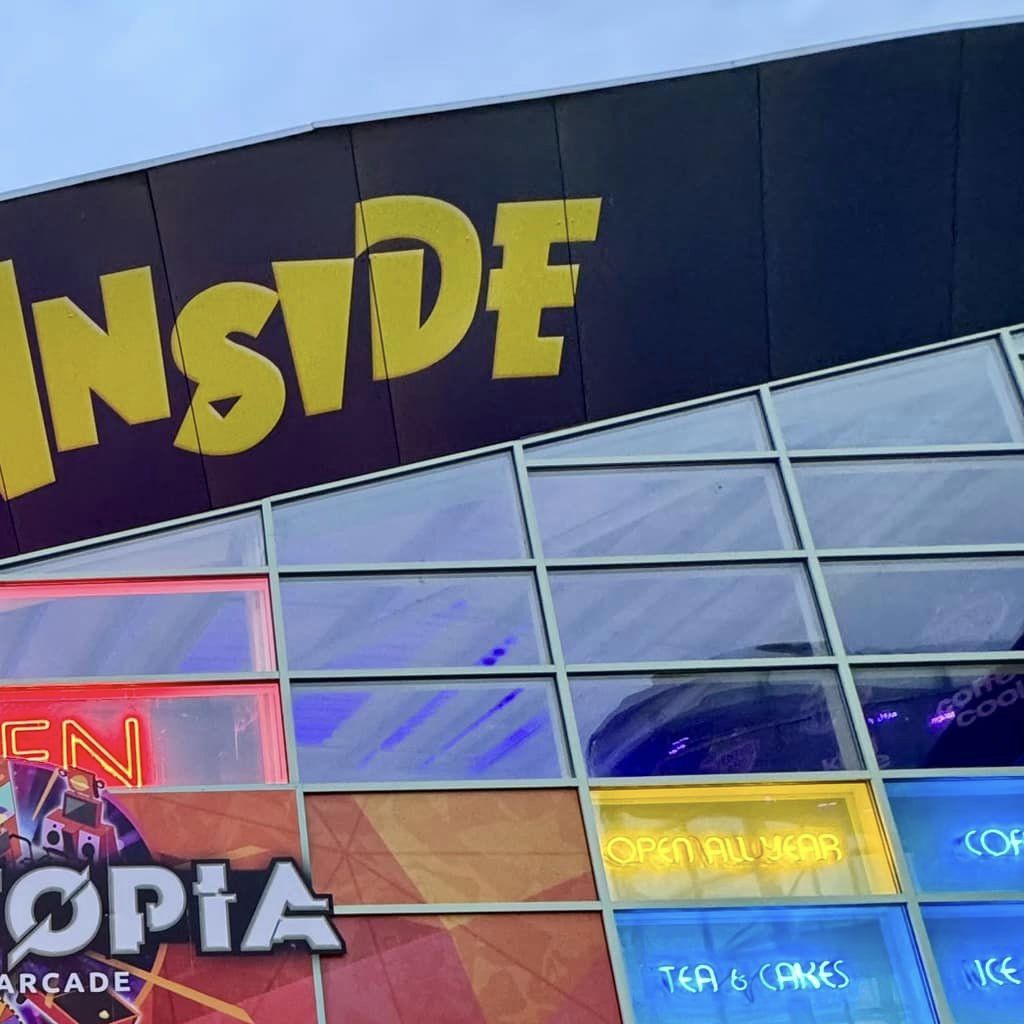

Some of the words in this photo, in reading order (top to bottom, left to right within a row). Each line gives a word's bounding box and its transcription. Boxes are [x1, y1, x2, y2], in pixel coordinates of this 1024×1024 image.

[605, 836, 695, 865] OPEN
[703, 834, 756, 864] ALL
[764, 832, 843, 864] YEAR
[658, 963, 718, 993] TEA
[731, 967, 747, 992] &
[760, 960, 850, 991] CAKES
[975, 957, 1022, 987] ICE
